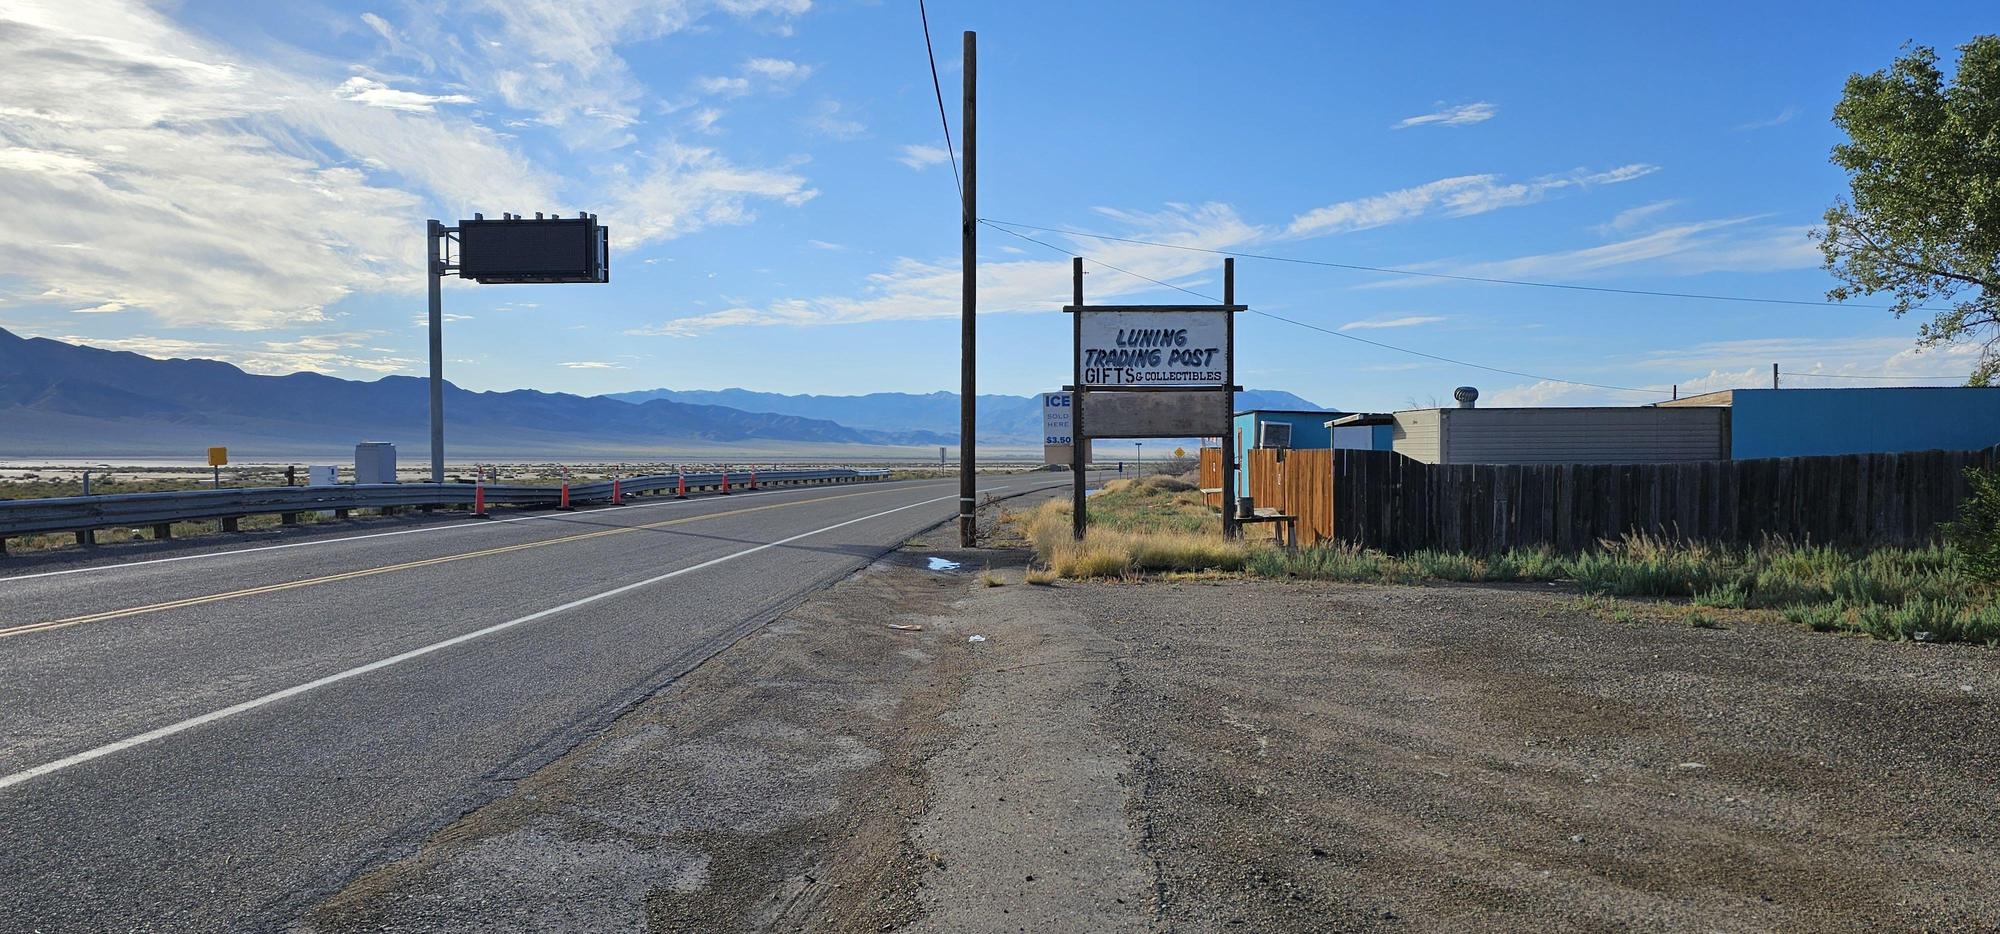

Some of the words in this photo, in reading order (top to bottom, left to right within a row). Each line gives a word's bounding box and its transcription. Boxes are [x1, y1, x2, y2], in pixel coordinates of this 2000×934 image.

[1116, 329, 1188, 347] LUNING
[1085, 348, 1162, 368] TRADING
[1167, 348, 1219, 367] POST
[1085, 367, 1135, 384] GIFTS
[1135, 373, 1144, 382] &
[1145, 371, 1222, 381] COLLECTIBLES
[1045, 395, 1070, 407] ICE
[1046, 436, 1071, 444] $3.50
